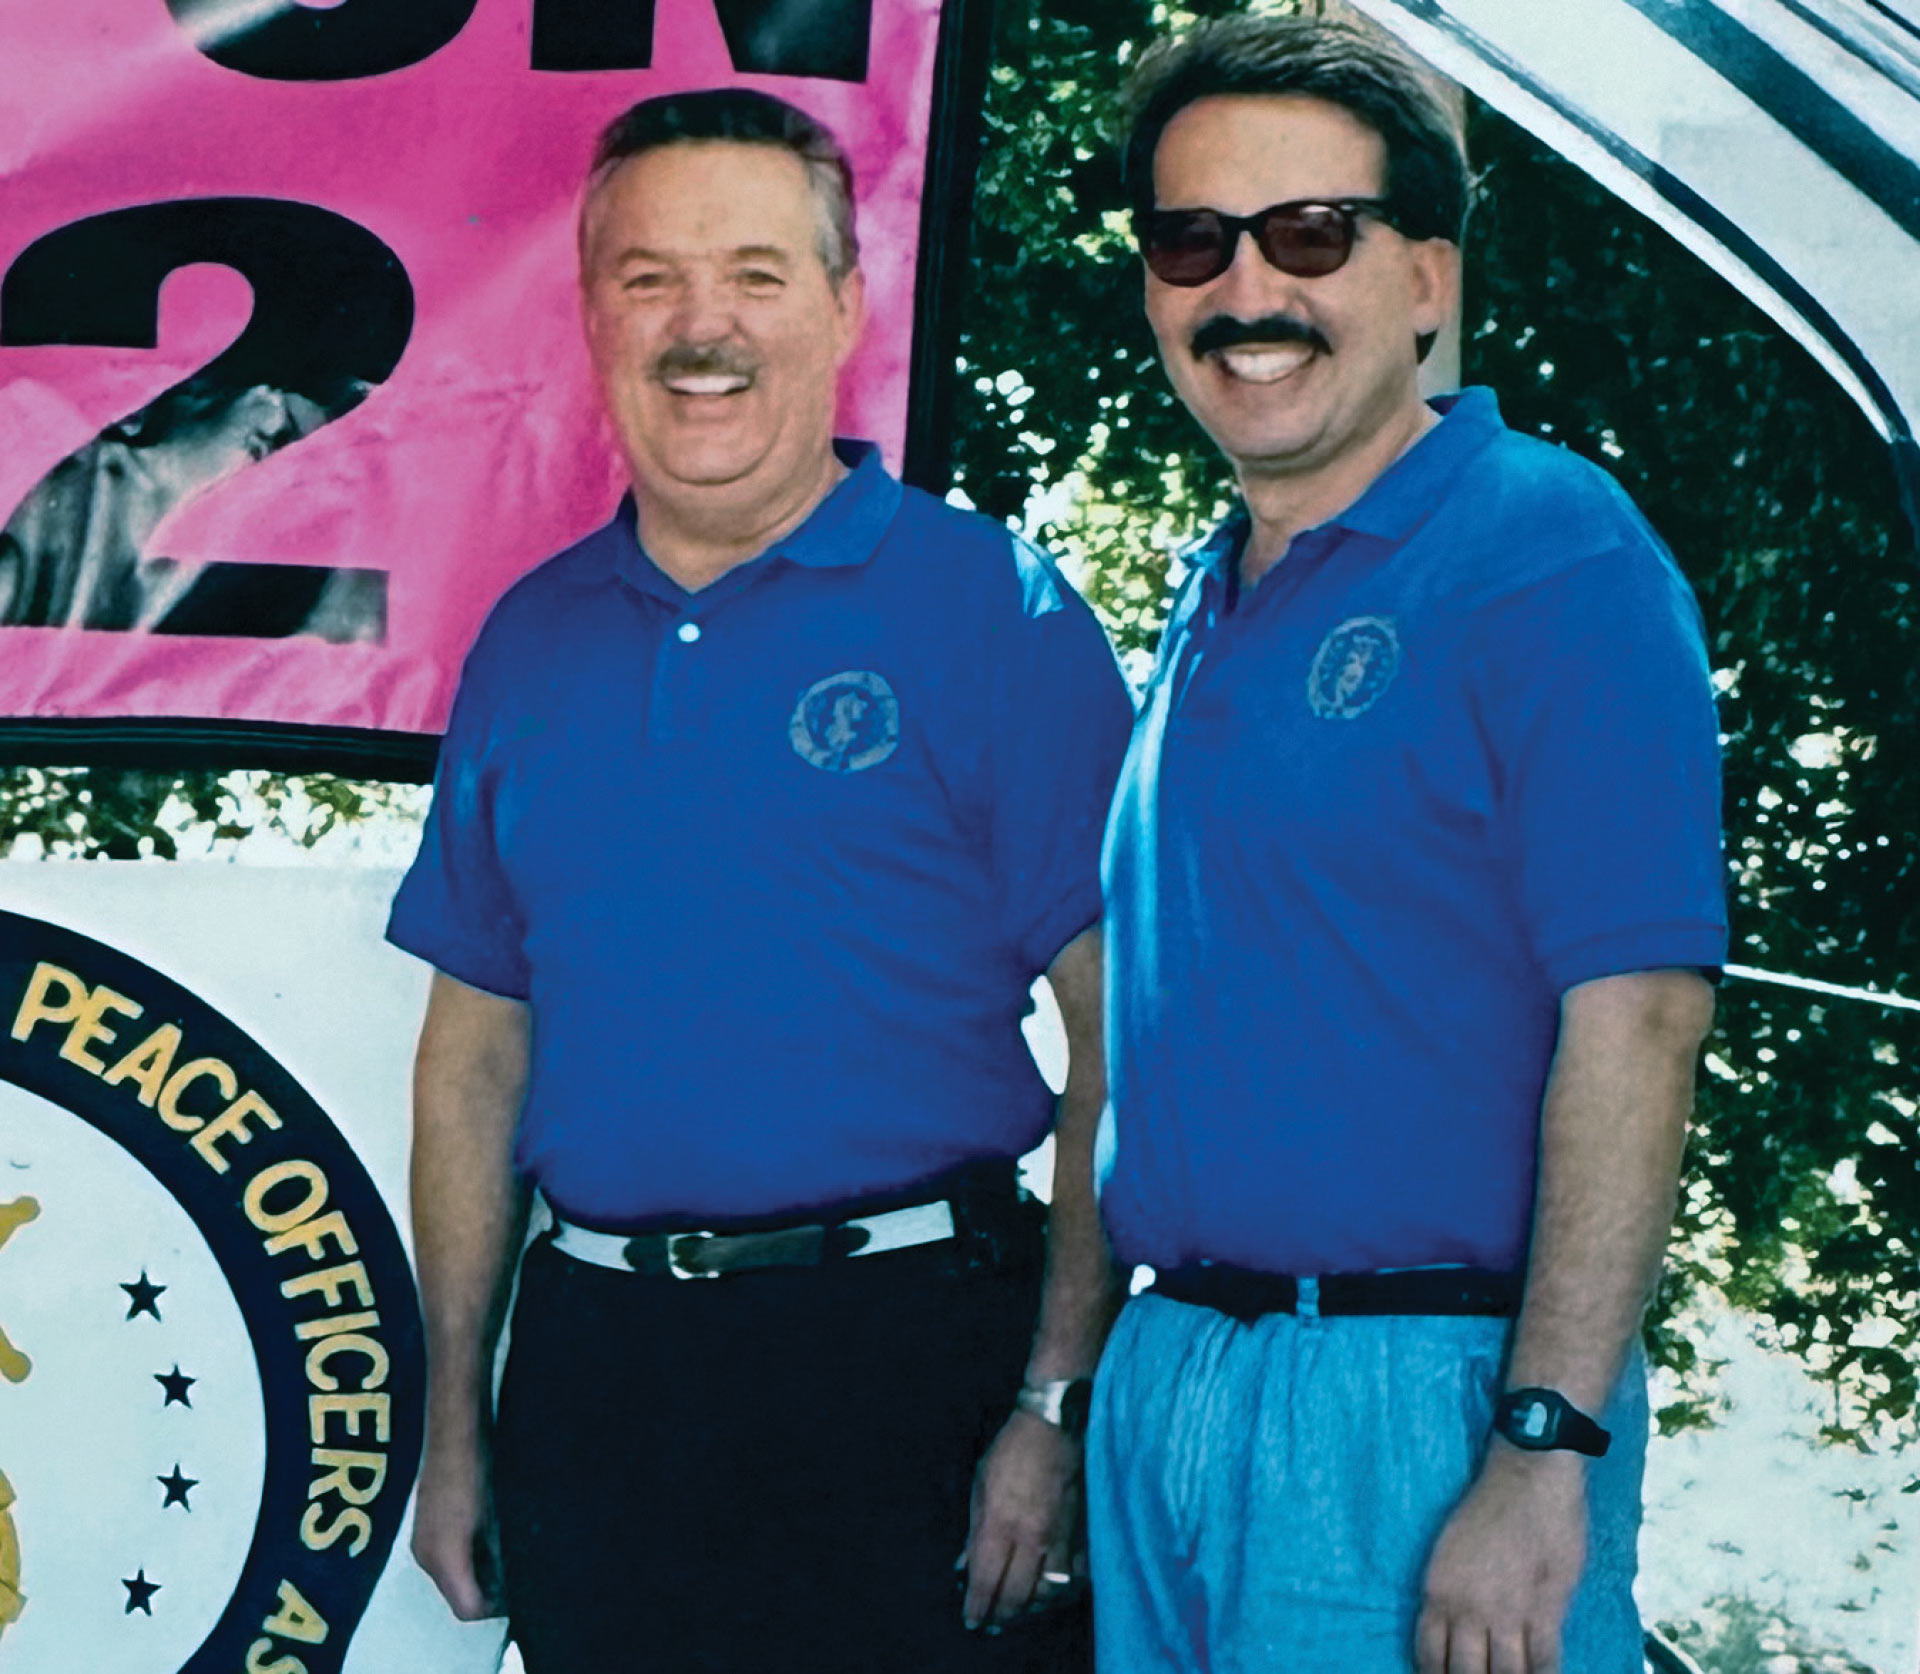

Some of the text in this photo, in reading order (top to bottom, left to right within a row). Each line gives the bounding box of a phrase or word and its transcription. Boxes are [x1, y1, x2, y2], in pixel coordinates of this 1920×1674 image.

[0, 196, 415, 644] 2
[11, 961, 283, 1174] PEACE
[243, 1159, 391, 1557] OFFICERS
